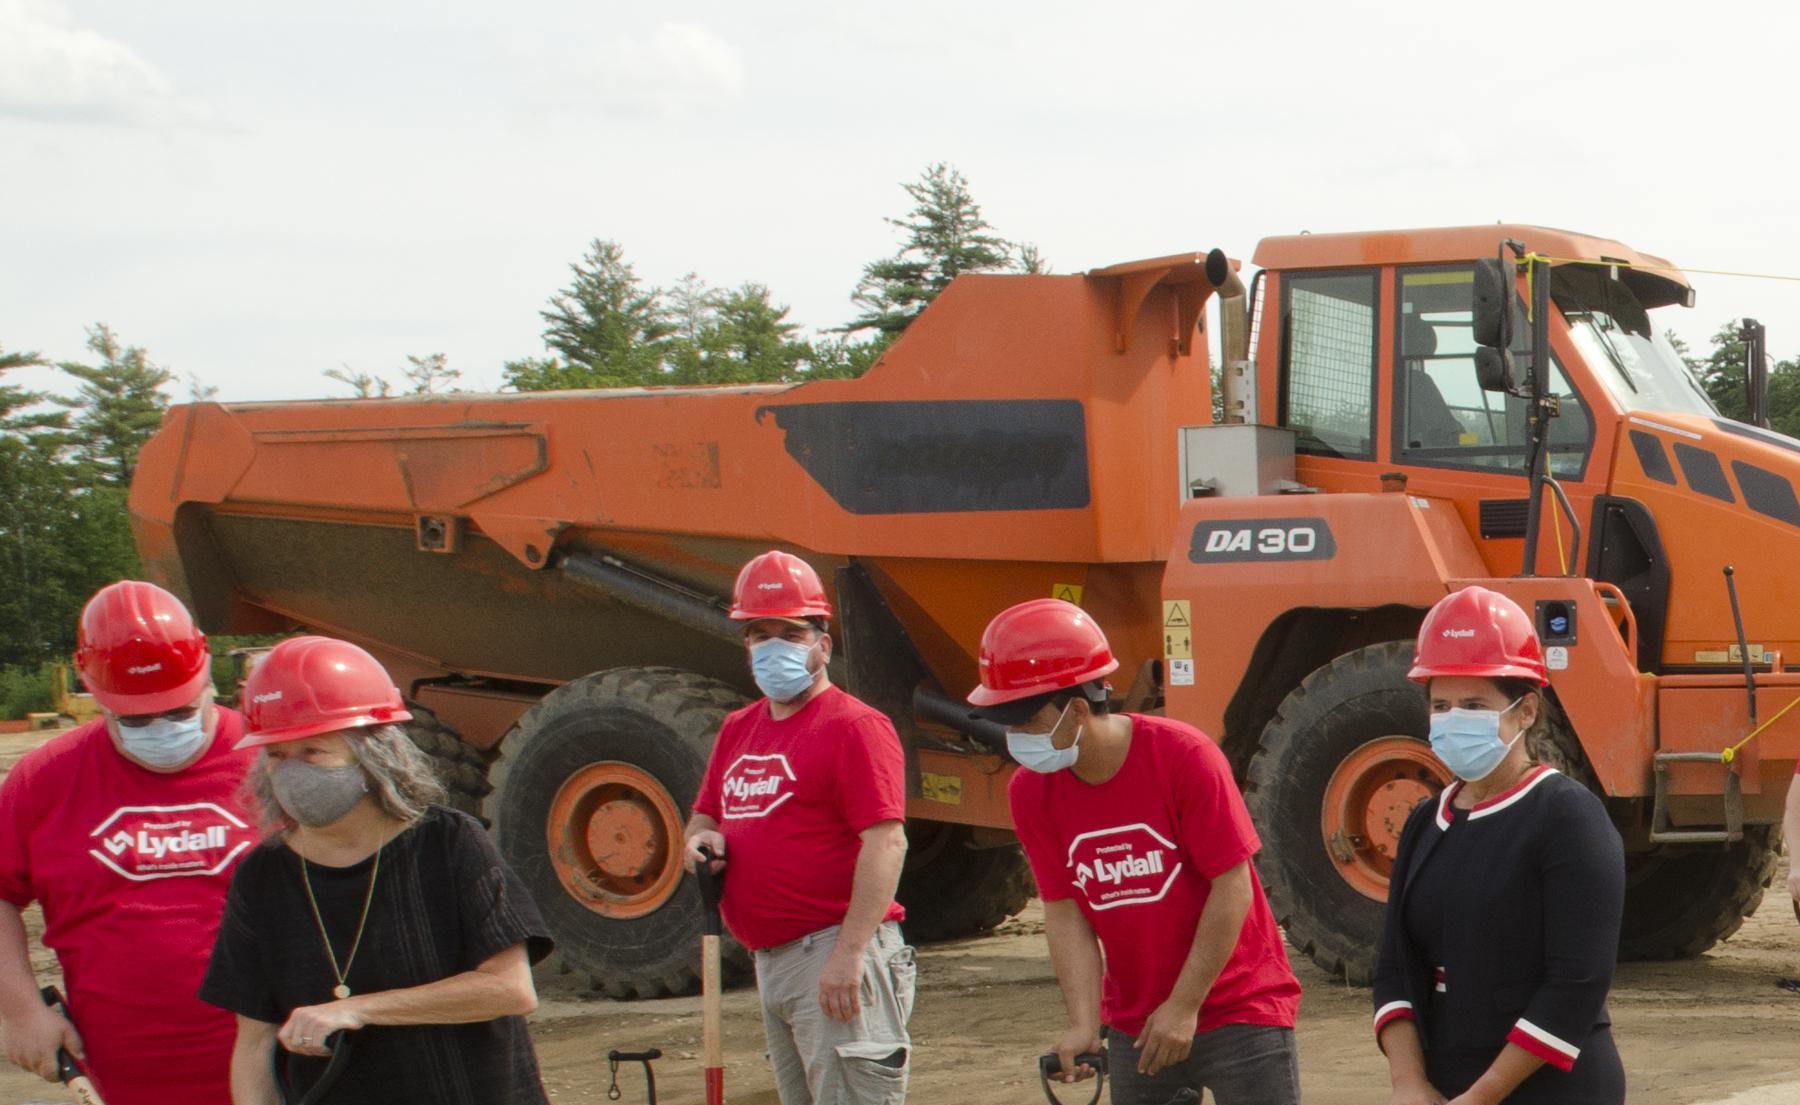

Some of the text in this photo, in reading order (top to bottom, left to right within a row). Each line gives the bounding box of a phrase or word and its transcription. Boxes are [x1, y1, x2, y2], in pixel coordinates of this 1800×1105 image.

[733, 776, 780, 802] Lydall
[137, 825, 226, 858] Lydall
[1093, 850, 1164, 885] Lydall
